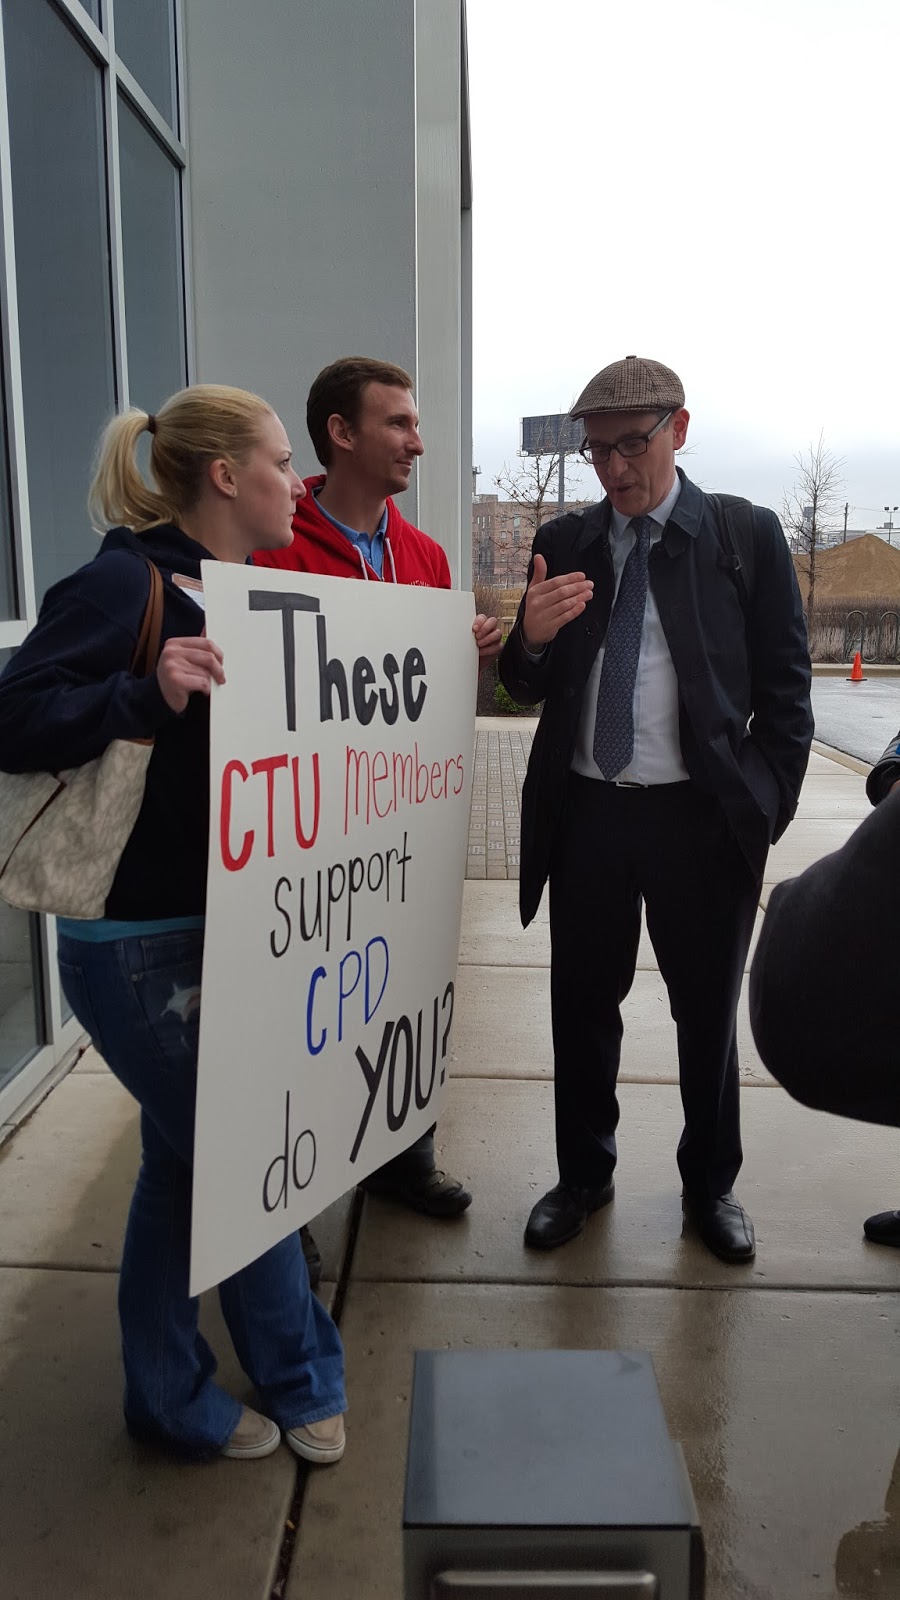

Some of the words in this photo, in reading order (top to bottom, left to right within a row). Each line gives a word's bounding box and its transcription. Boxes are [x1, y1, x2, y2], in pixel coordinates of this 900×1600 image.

[248, 590, 428, 732] These
[220, 753, 320, 872] CTU
[344, 742, 464, 836] members
[270, 831, 413, 958] support
[306, 936, 390, 1057] CPD
[262, 1090, 317, 1214] do
[349, 981, 455, 1165] YOU?
